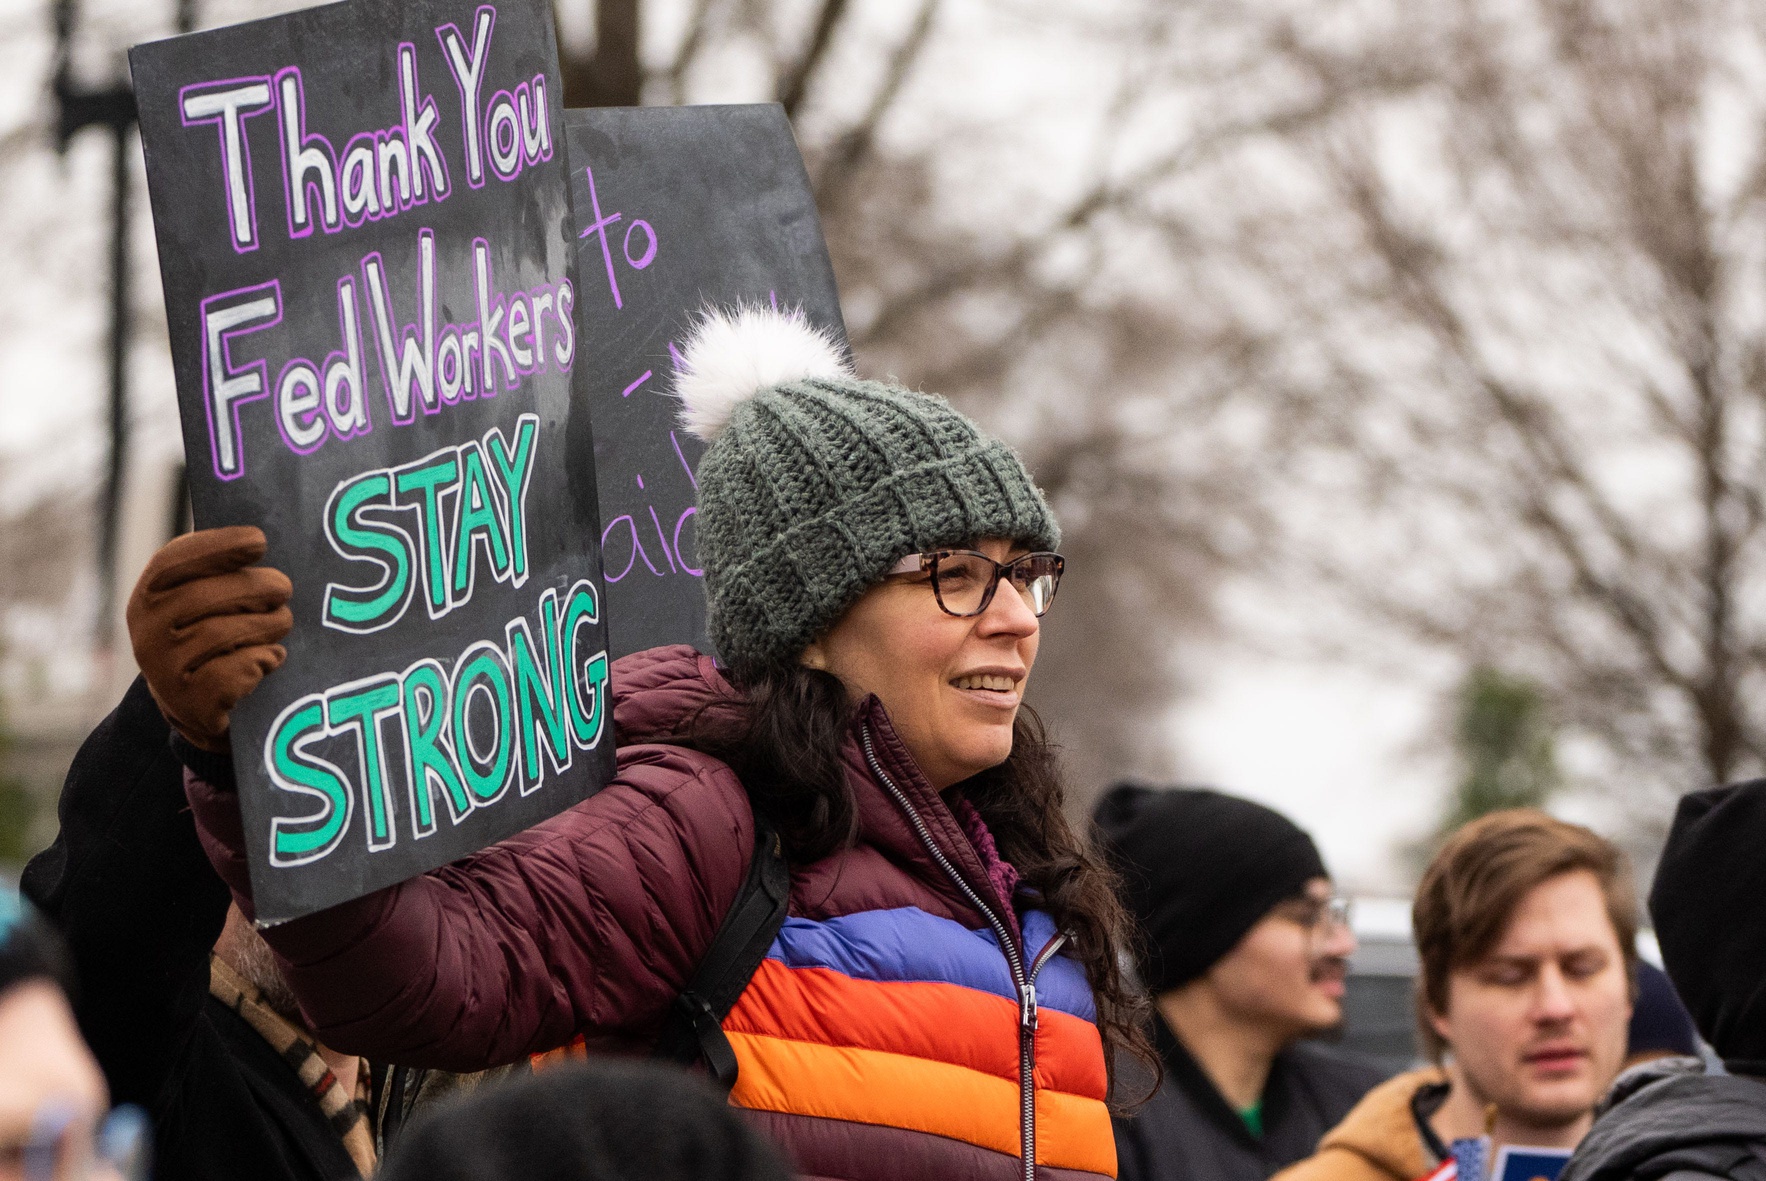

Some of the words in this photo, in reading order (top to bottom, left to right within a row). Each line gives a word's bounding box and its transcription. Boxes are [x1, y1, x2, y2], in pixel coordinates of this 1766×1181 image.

[180, 43, 451, 253] Thank
[436, 5, 552, 188] You
[578, 166, 658, 310] to
[201, 276, 371, 480] Fed
[363, 228, 575, 426] Workers
[323, 413, 539, 634] STAY
[264, 579, 607, 867] STRONG
